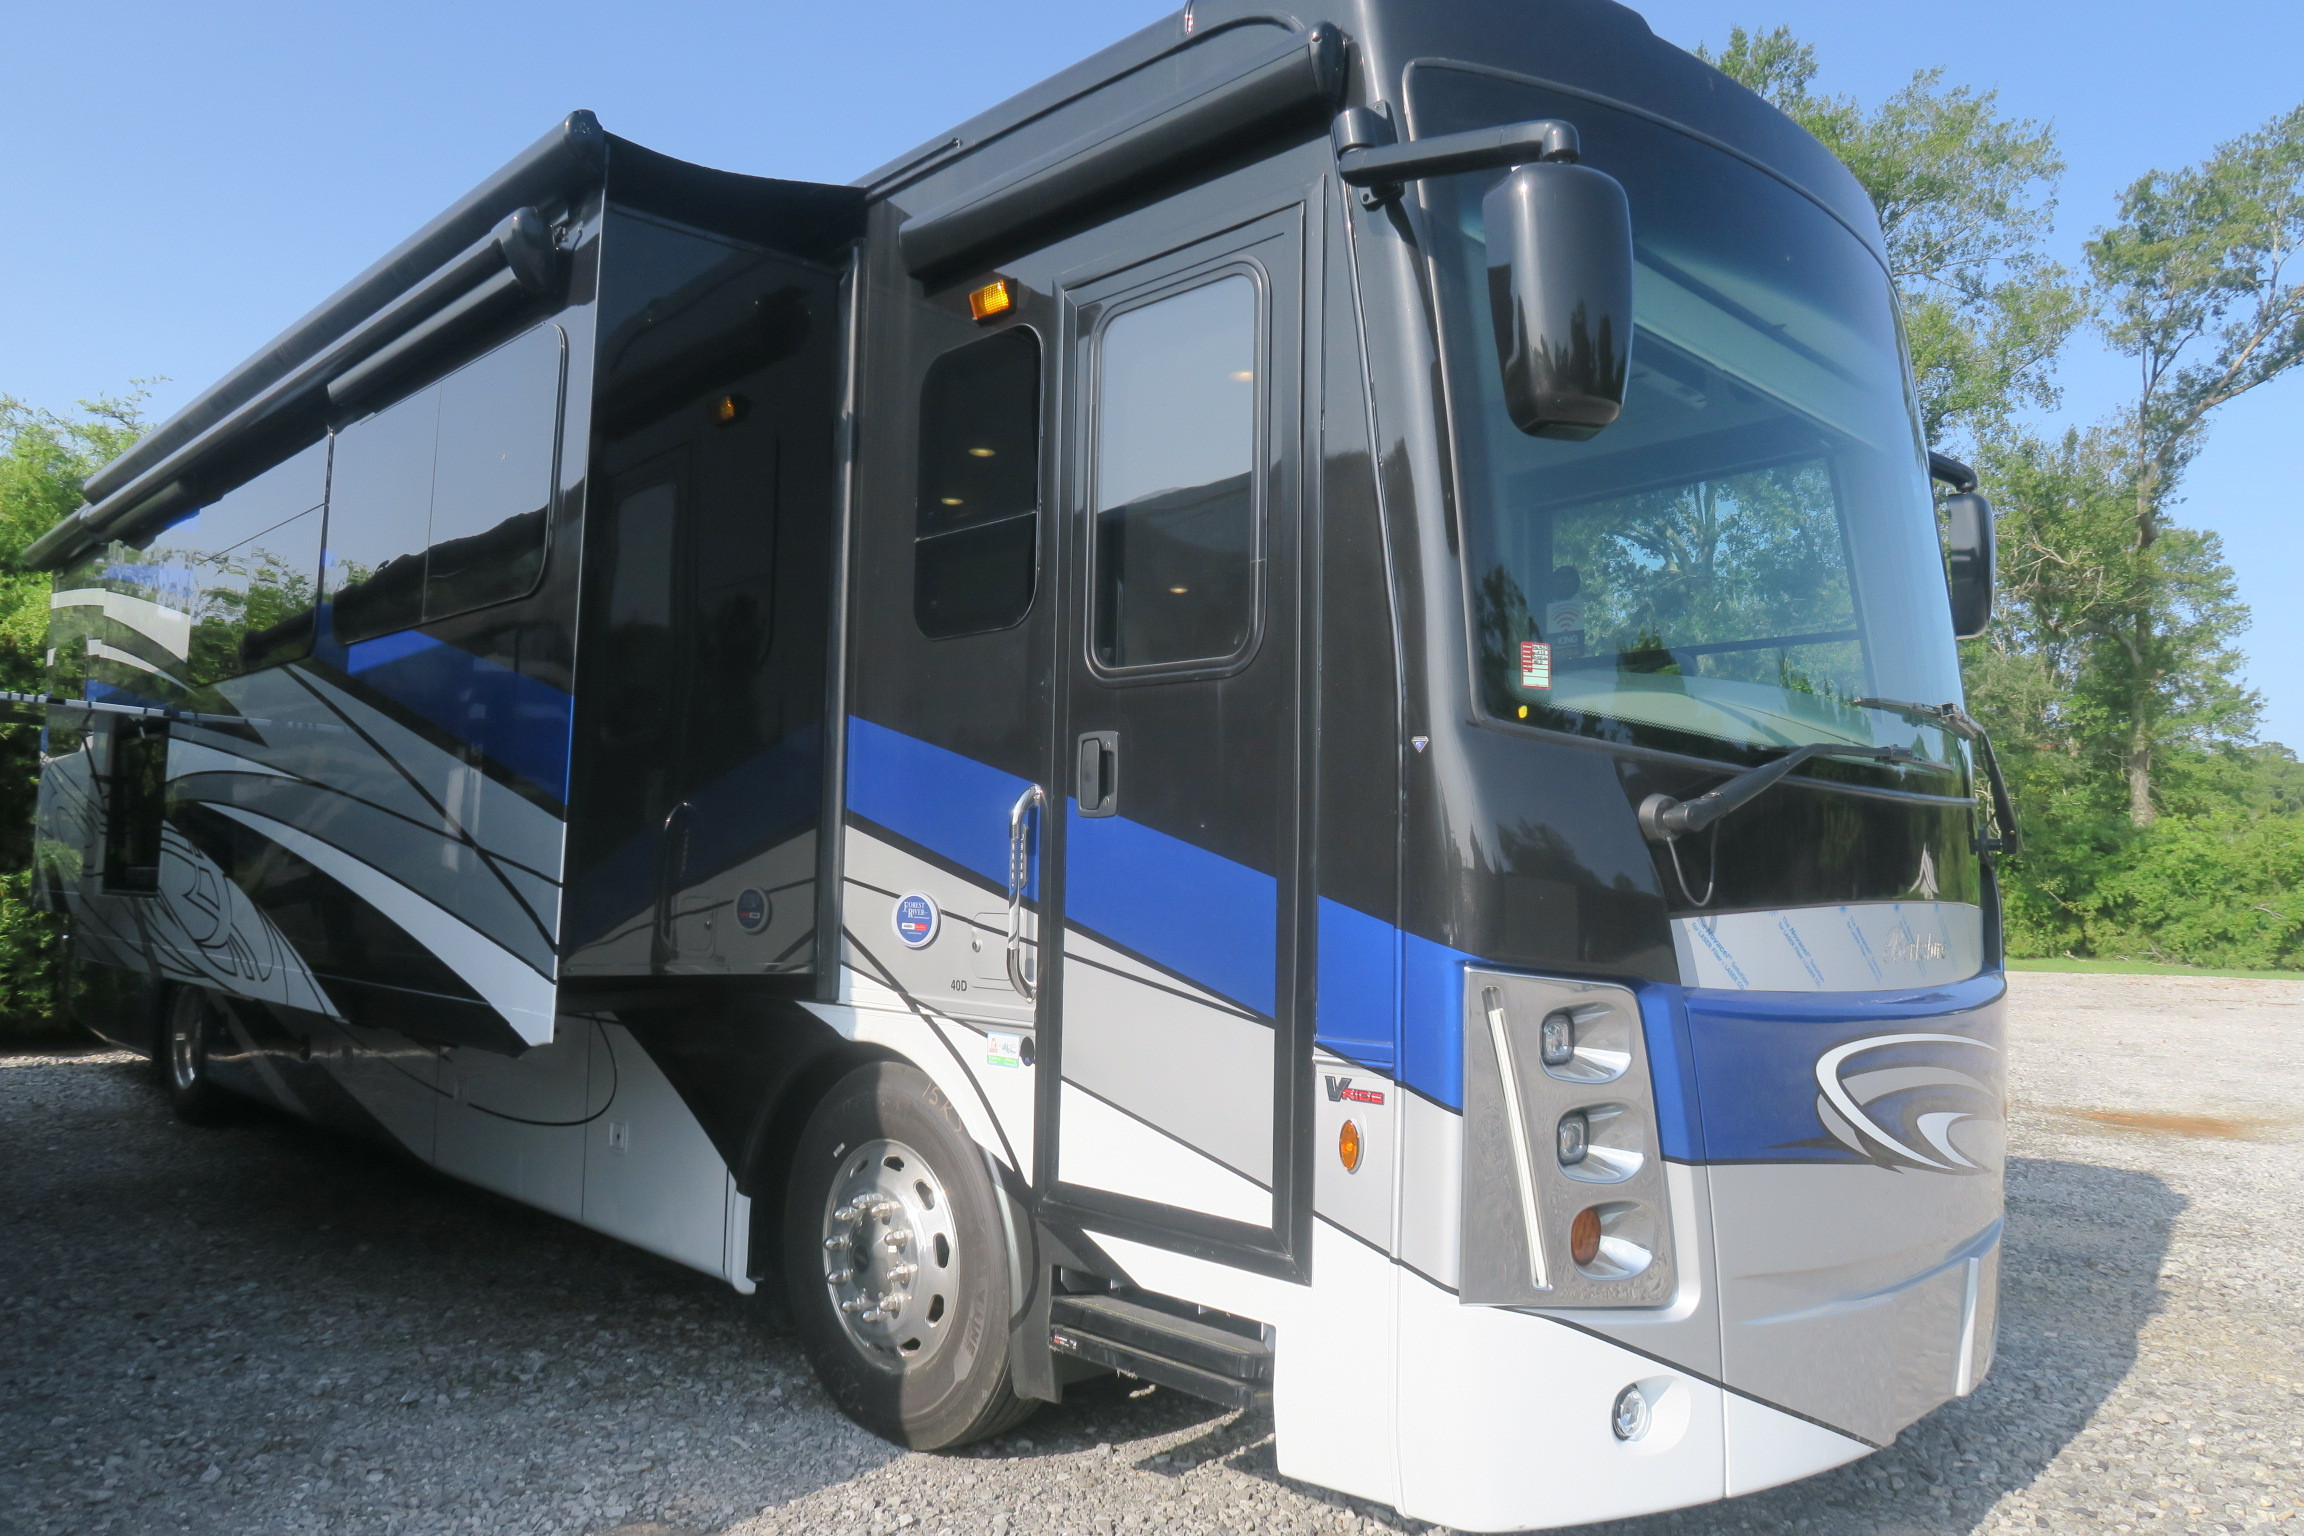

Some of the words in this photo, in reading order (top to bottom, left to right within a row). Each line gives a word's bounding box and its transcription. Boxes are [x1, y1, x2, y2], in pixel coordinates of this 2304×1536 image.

[1557, 634, 1578, 645] KING
[902, 901, 926, 912] FOREST
[907, 907, 925, 918] RIVER
[1698, 931, 1713, 948] LASER
[951, 980, 967, 991] 40D
